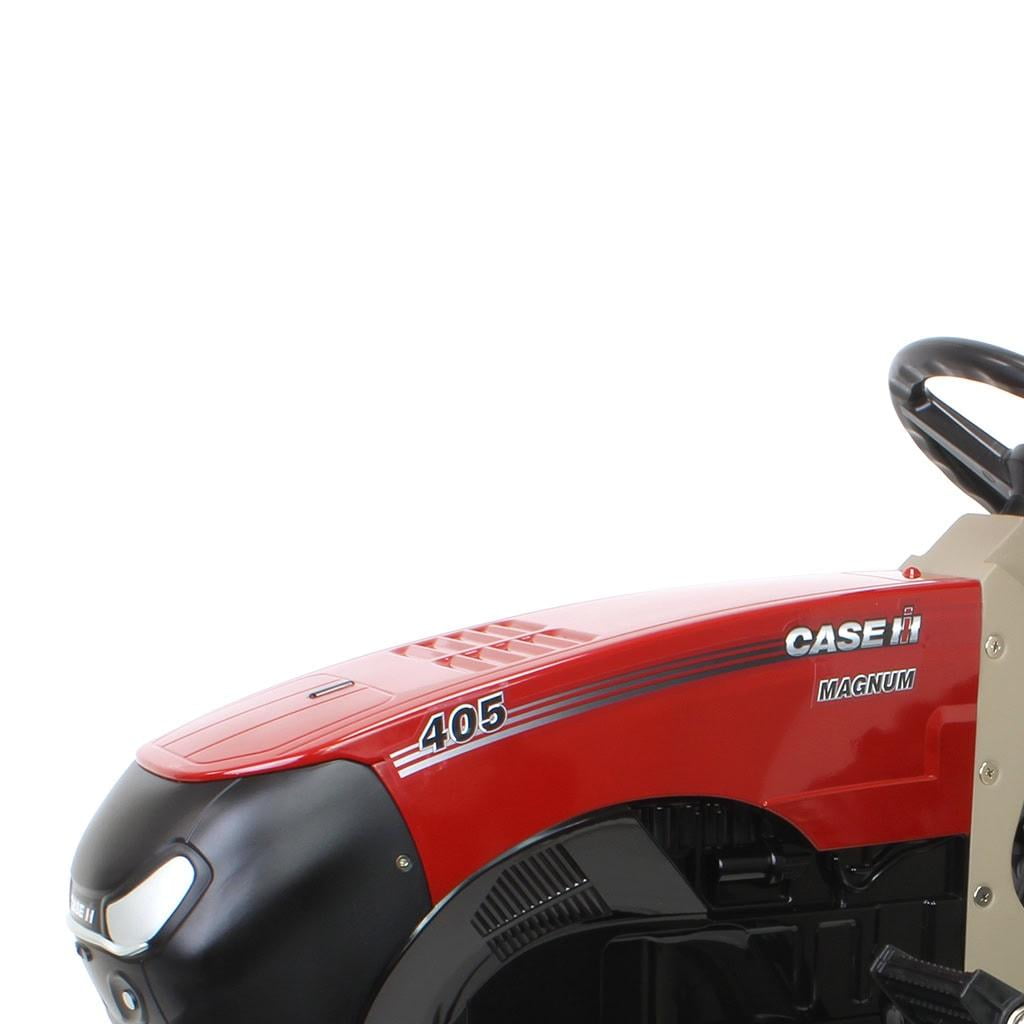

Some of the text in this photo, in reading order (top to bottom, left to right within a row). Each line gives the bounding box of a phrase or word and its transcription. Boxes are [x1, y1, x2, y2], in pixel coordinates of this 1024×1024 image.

[785, 618, 887, 657] CASE
[817, 668, 917, 702] MAGNUM
[419, 691, 508, 753] 405
